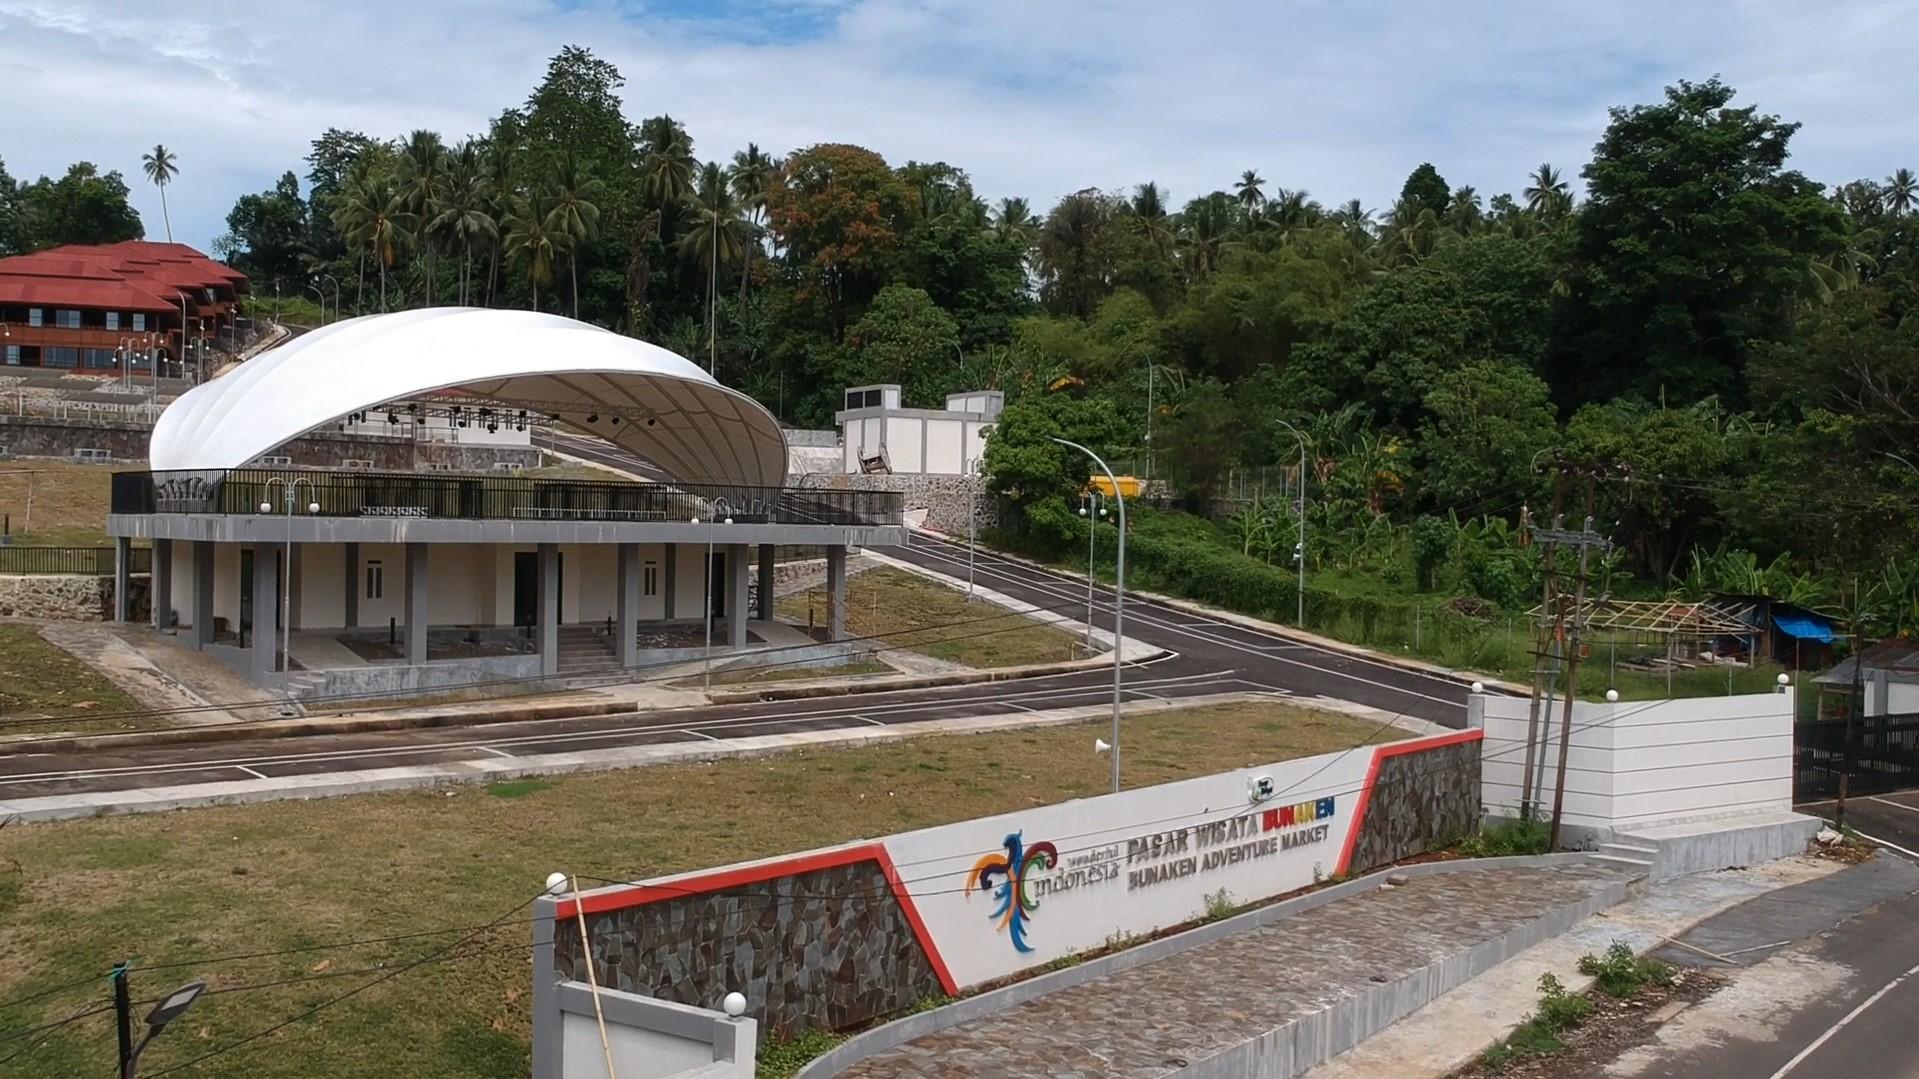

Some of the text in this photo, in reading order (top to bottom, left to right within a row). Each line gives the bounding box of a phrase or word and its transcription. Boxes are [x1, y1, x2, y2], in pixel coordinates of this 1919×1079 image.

[1127, 796, 1335, 864] PASAR WISATA BUNAKEN
[1127, 824, 1329, 890] BUNAKEN ADVENTURE MARKET
[1034, 862, 1120, 897] indonesia
